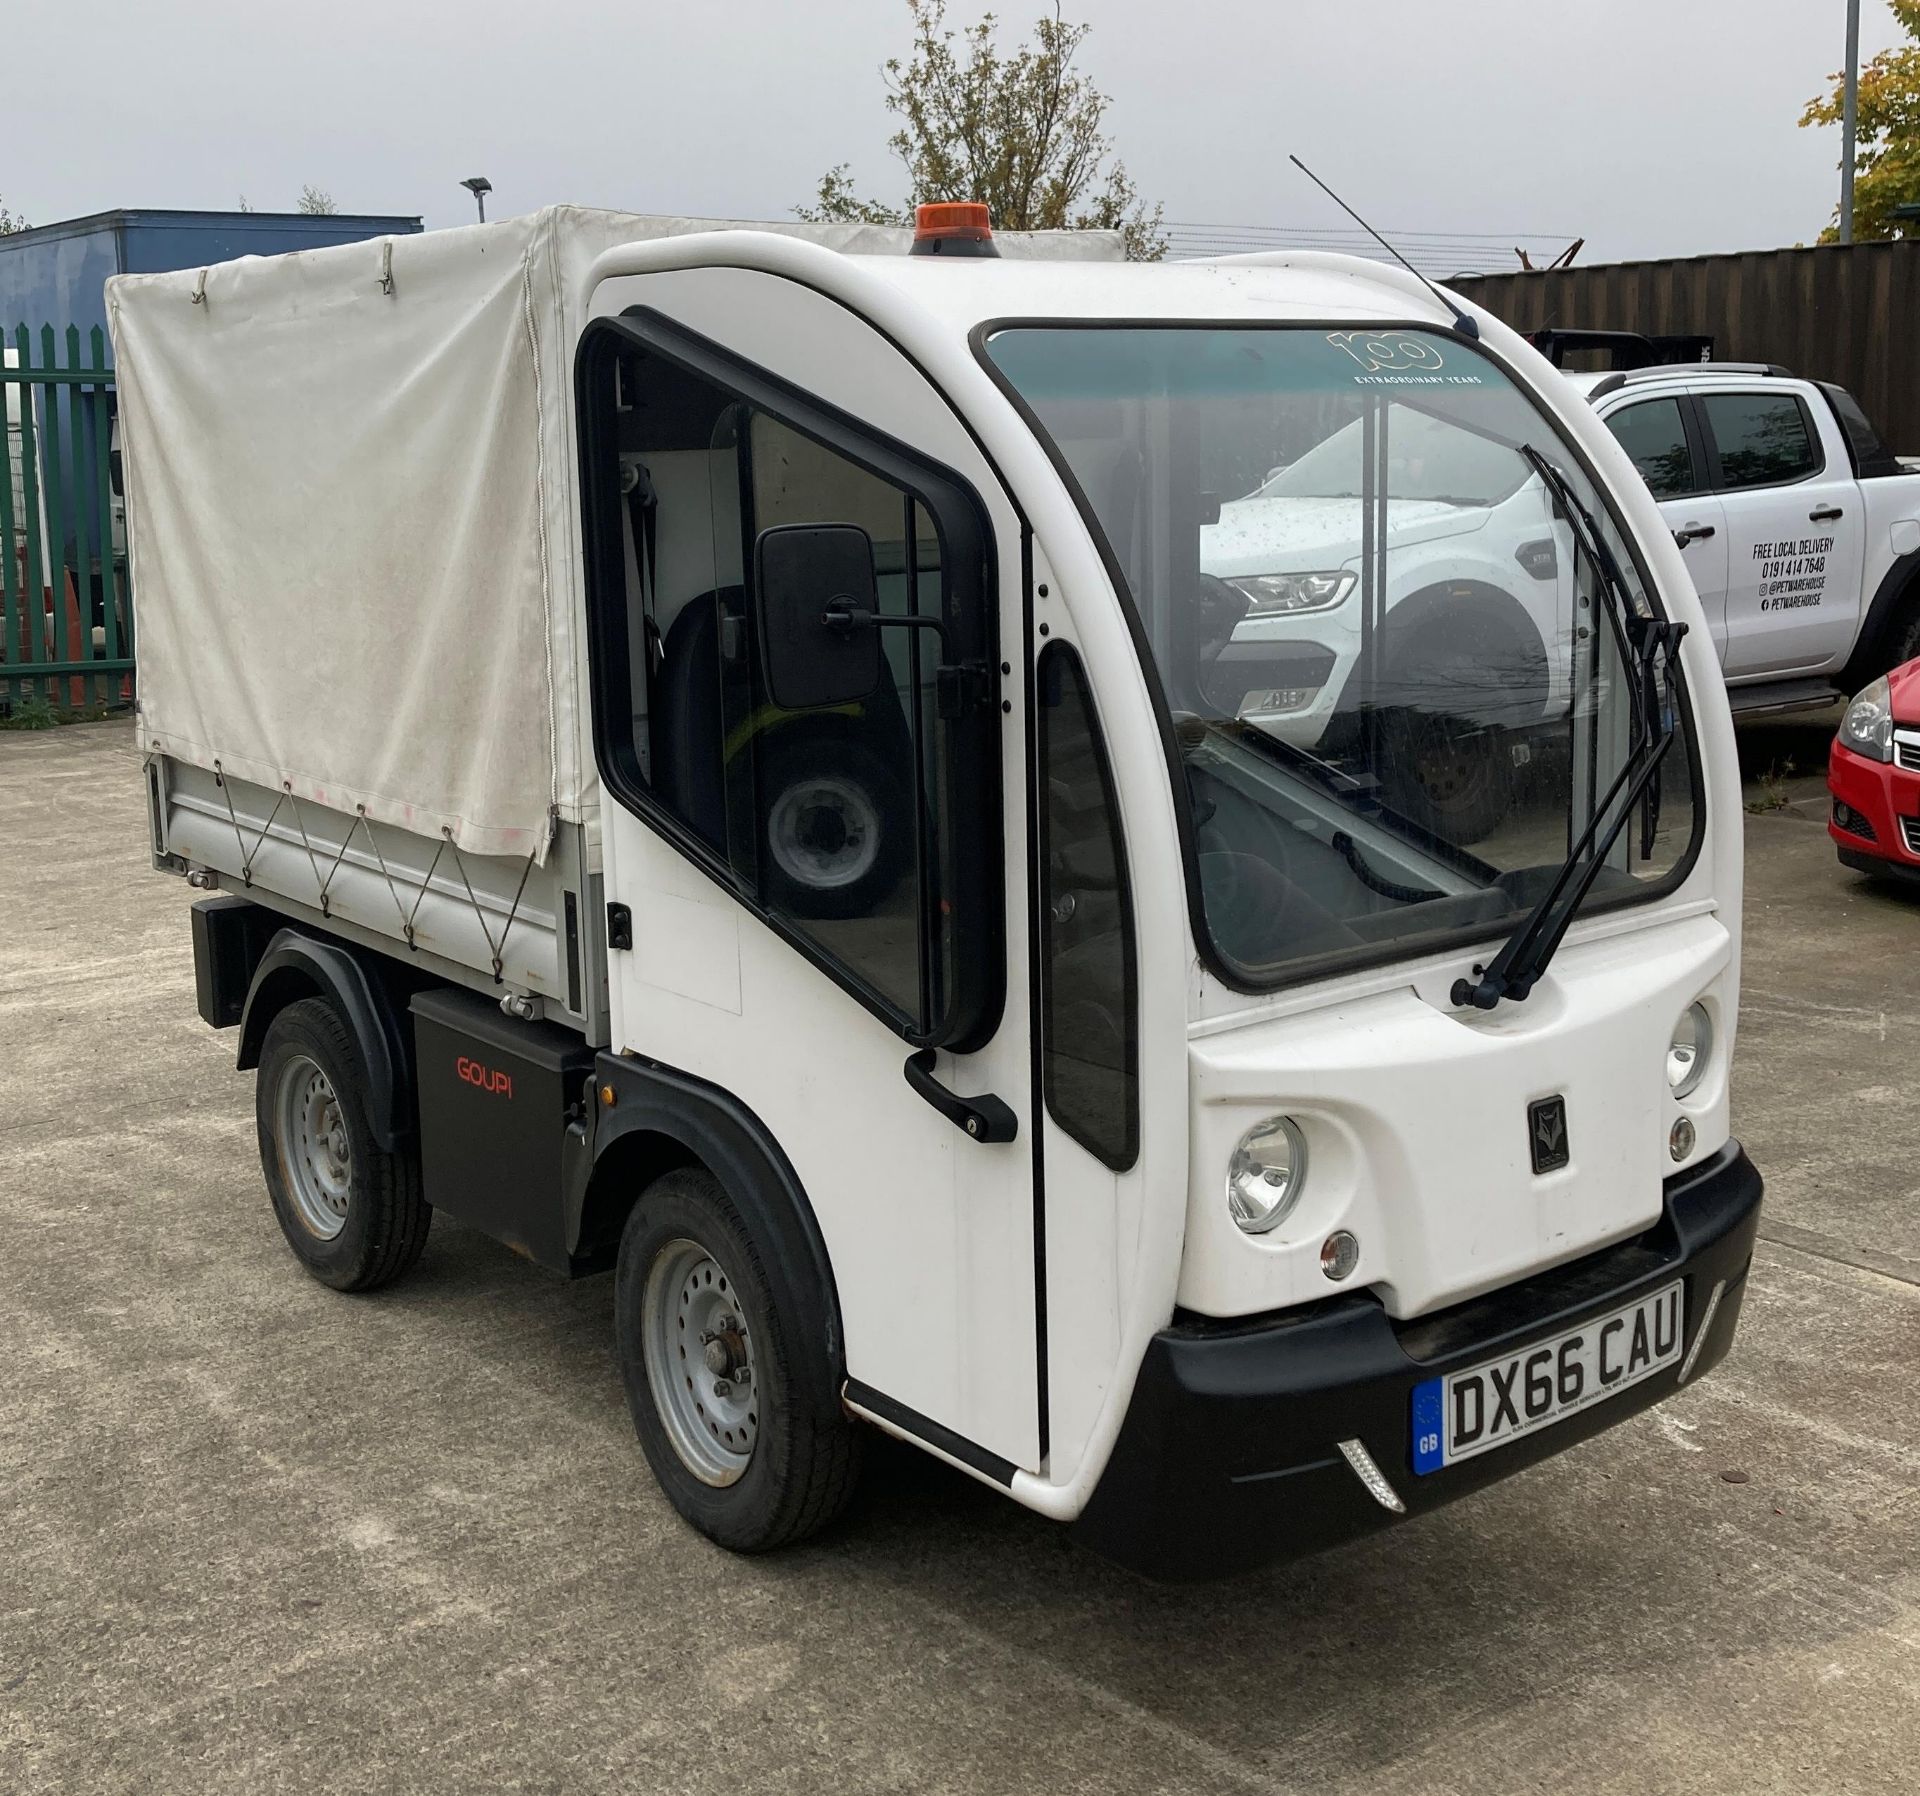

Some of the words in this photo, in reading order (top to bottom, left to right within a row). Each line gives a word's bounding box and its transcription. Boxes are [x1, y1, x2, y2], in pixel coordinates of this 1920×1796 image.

[1326, 333, 1443, 372] 100
[1354, 376, 1444, 384] EXTRAORDINARY
[1448, 376, 1482, 384] YEARS
[1753, 543, 1773, 560] FREE
[1774, 540, 1797, 558] LOCAL
[1799, 537, 1835, 556] DELIVERY
[1762, 561, 1784, 579] 0191
[1785, 559, 1802, 577] 414
[1804, 556, 1826, 575] 7648
[1769, 576, 1826, 595] @PETWAREHOUSE
[1771, 593, 1822, 611] PETWAREHOUSE
[1453, 1336, 1585, 1449] DX66
[1599, 1291, 1678, 1385] CAU
[1419, 1433, 1438, 1454] GB
